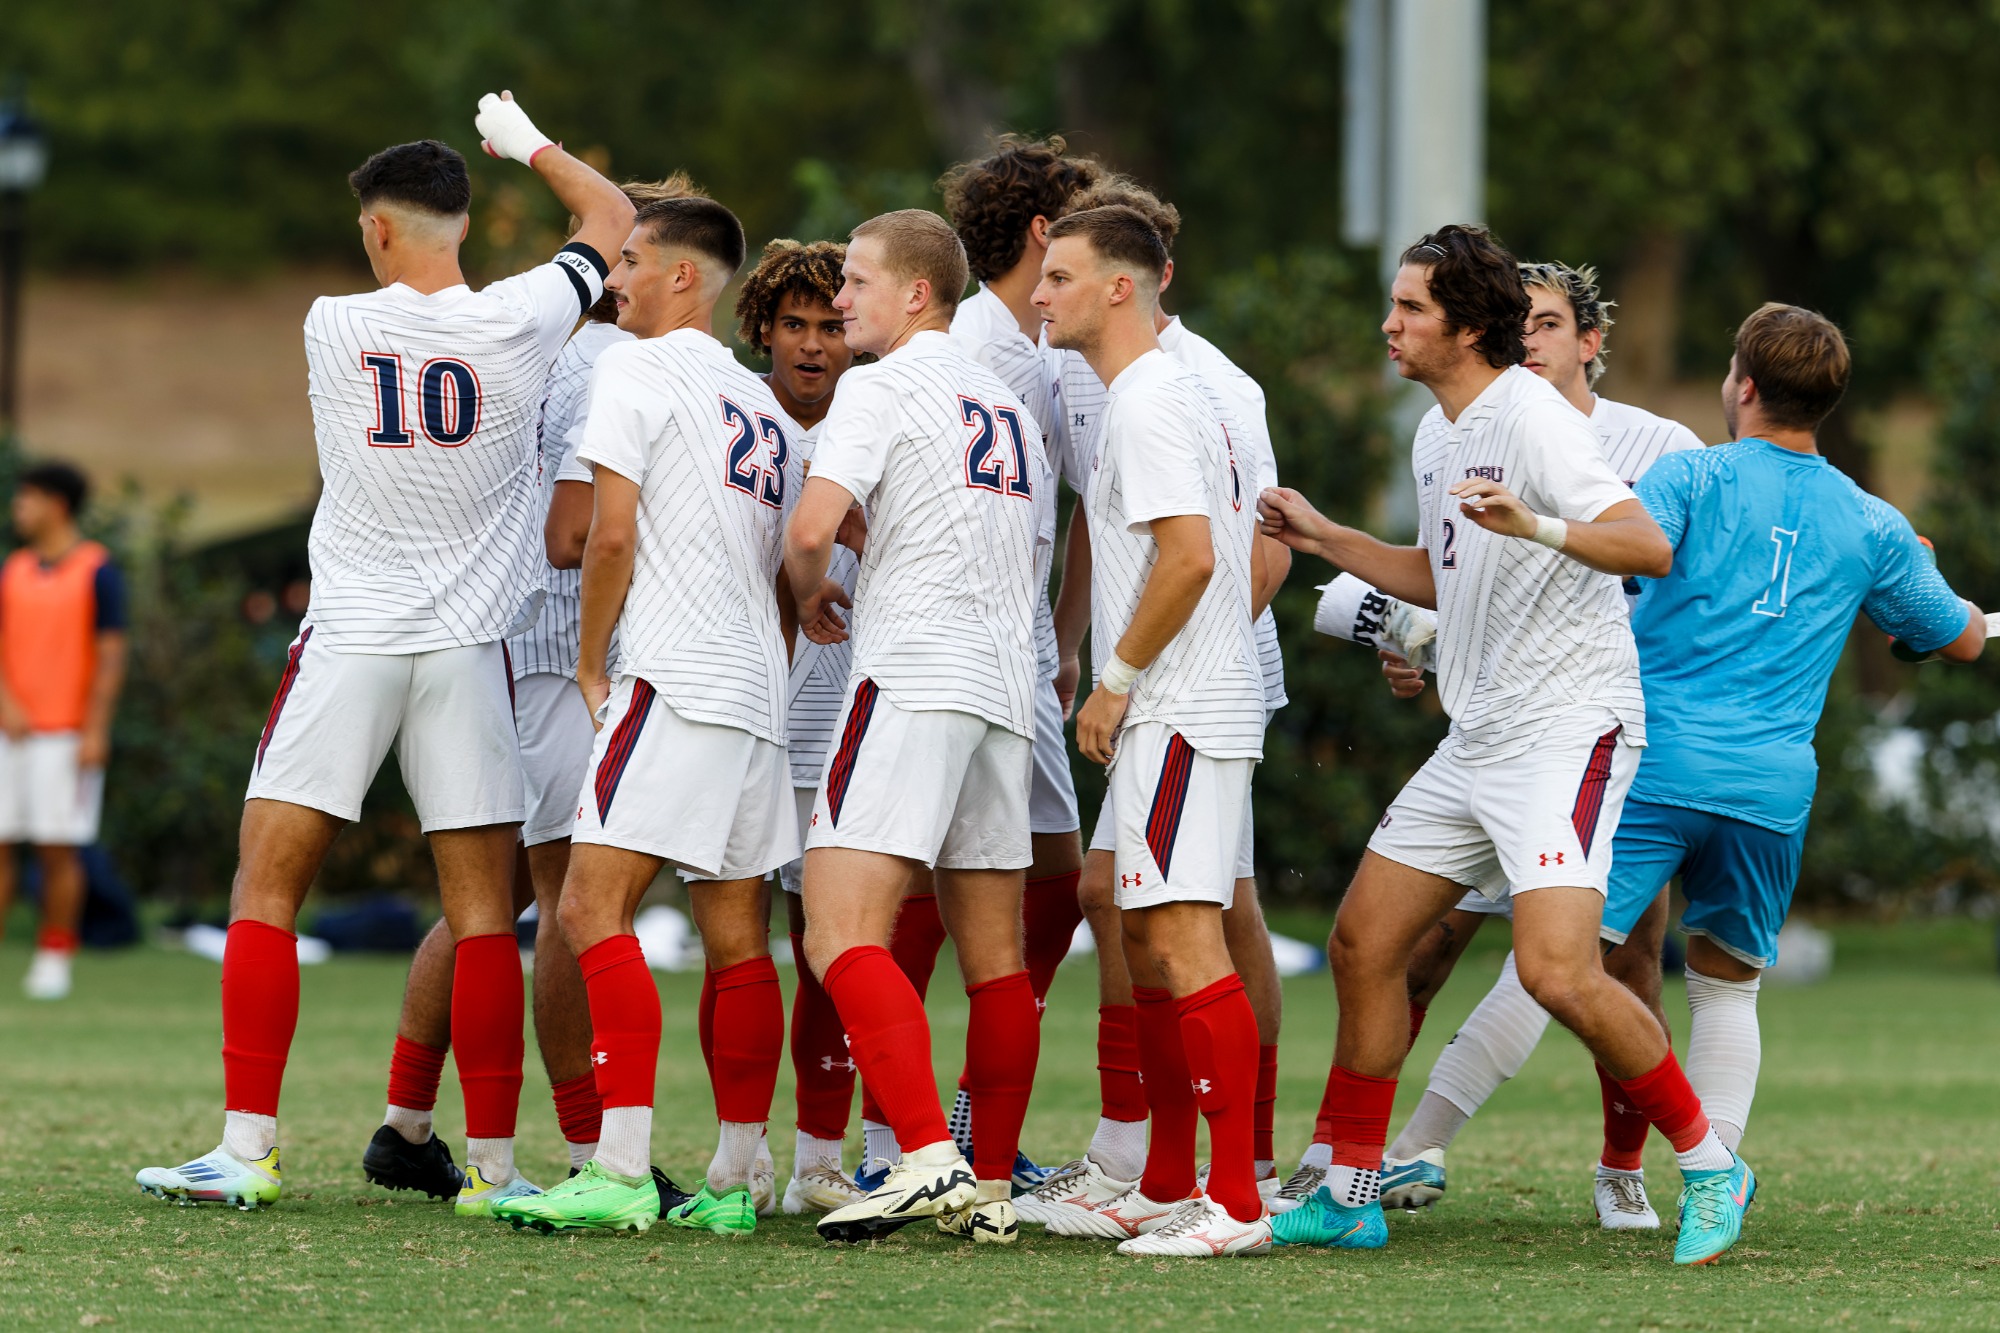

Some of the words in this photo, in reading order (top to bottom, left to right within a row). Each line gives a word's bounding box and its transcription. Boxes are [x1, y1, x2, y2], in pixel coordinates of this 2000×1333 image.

[361, 351, 482, 448] 10
[719, 394, 789, 510] 23
[957, 394, 1032, 502] 21
[1465, 466, 1504, 483] DBU
[1442, 518, 1457, 570] 2
[1751, 526, 1798, 617] 1
[1353, 588, 1388, 648] RA
